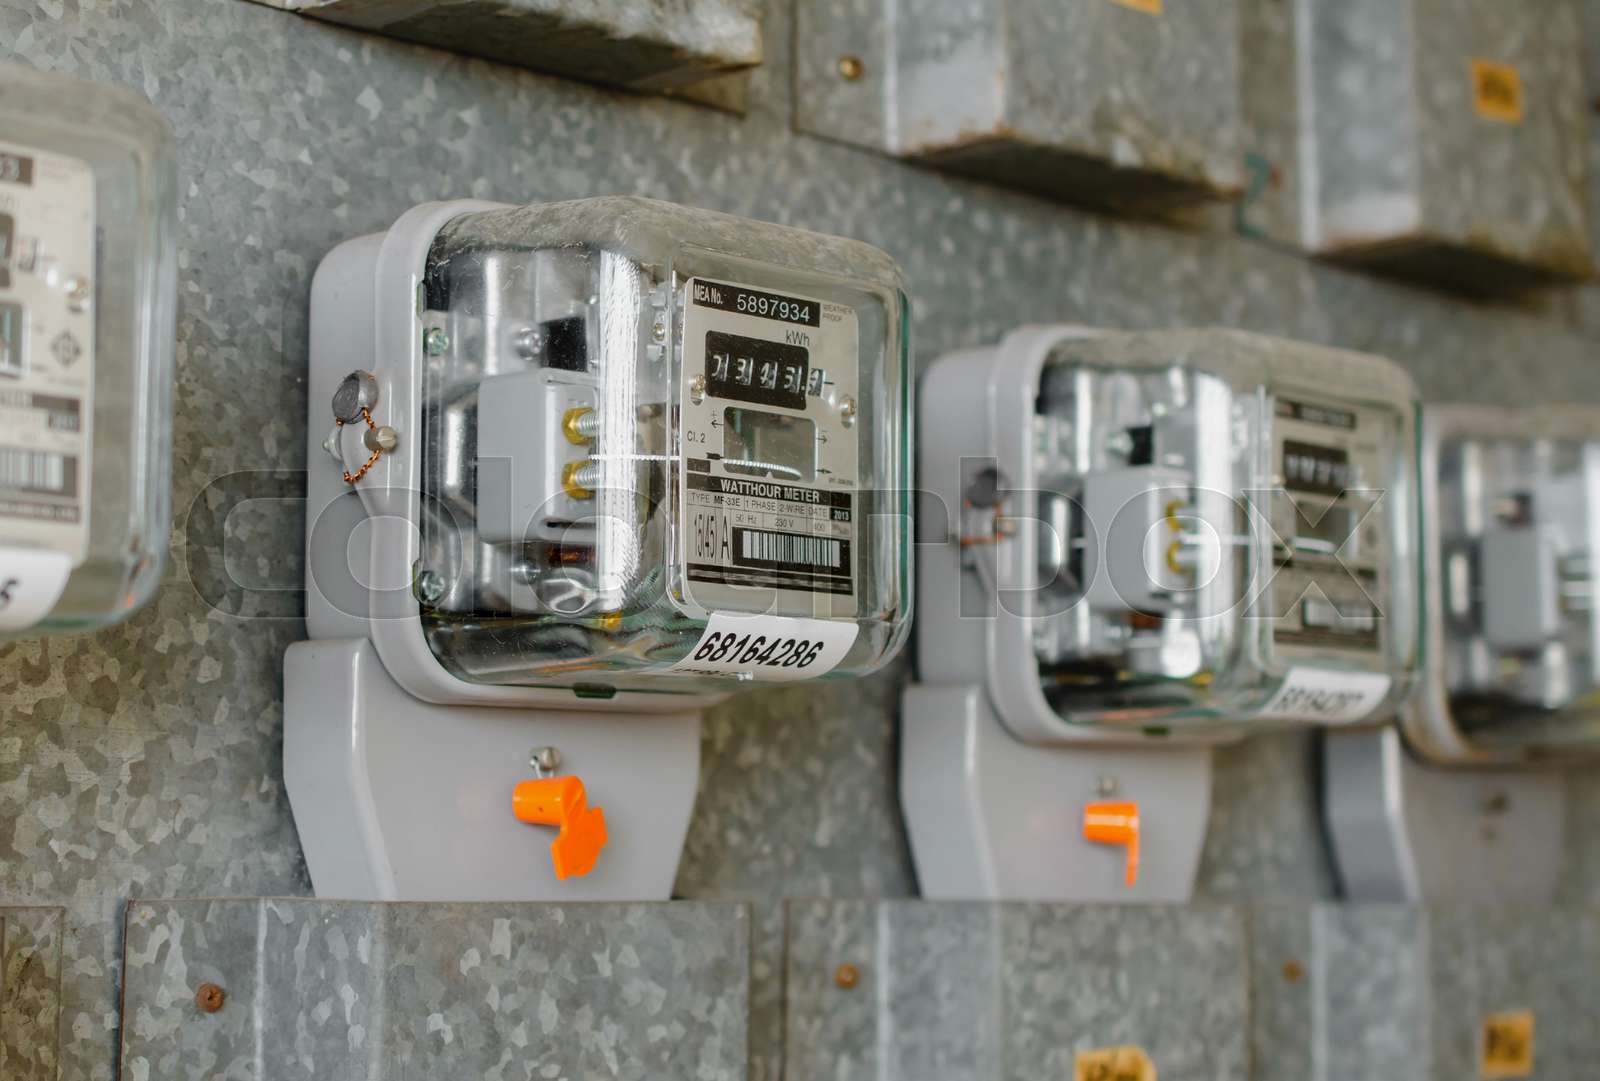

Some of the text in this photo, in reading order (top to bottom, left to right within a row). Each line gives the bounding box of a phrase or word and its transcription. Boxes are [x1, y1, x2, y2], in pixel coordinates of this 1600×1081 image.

[693, 283, 811, 323] MEA No. 5897934
[785, 329, 810, 347] kWh
[700, 432, 706, 444] 2
[691, 491, 711, 504] TYPE
[720, 478, 820, 504] WATTHOUR METER
[751, 500, 777, 512] PHASE
[808, 506, 850, 521] DATE 2013
[788, 519, 794, 529] V
[720, 514, 731, 561] A
[693, 631, 824, 668] 68164286
